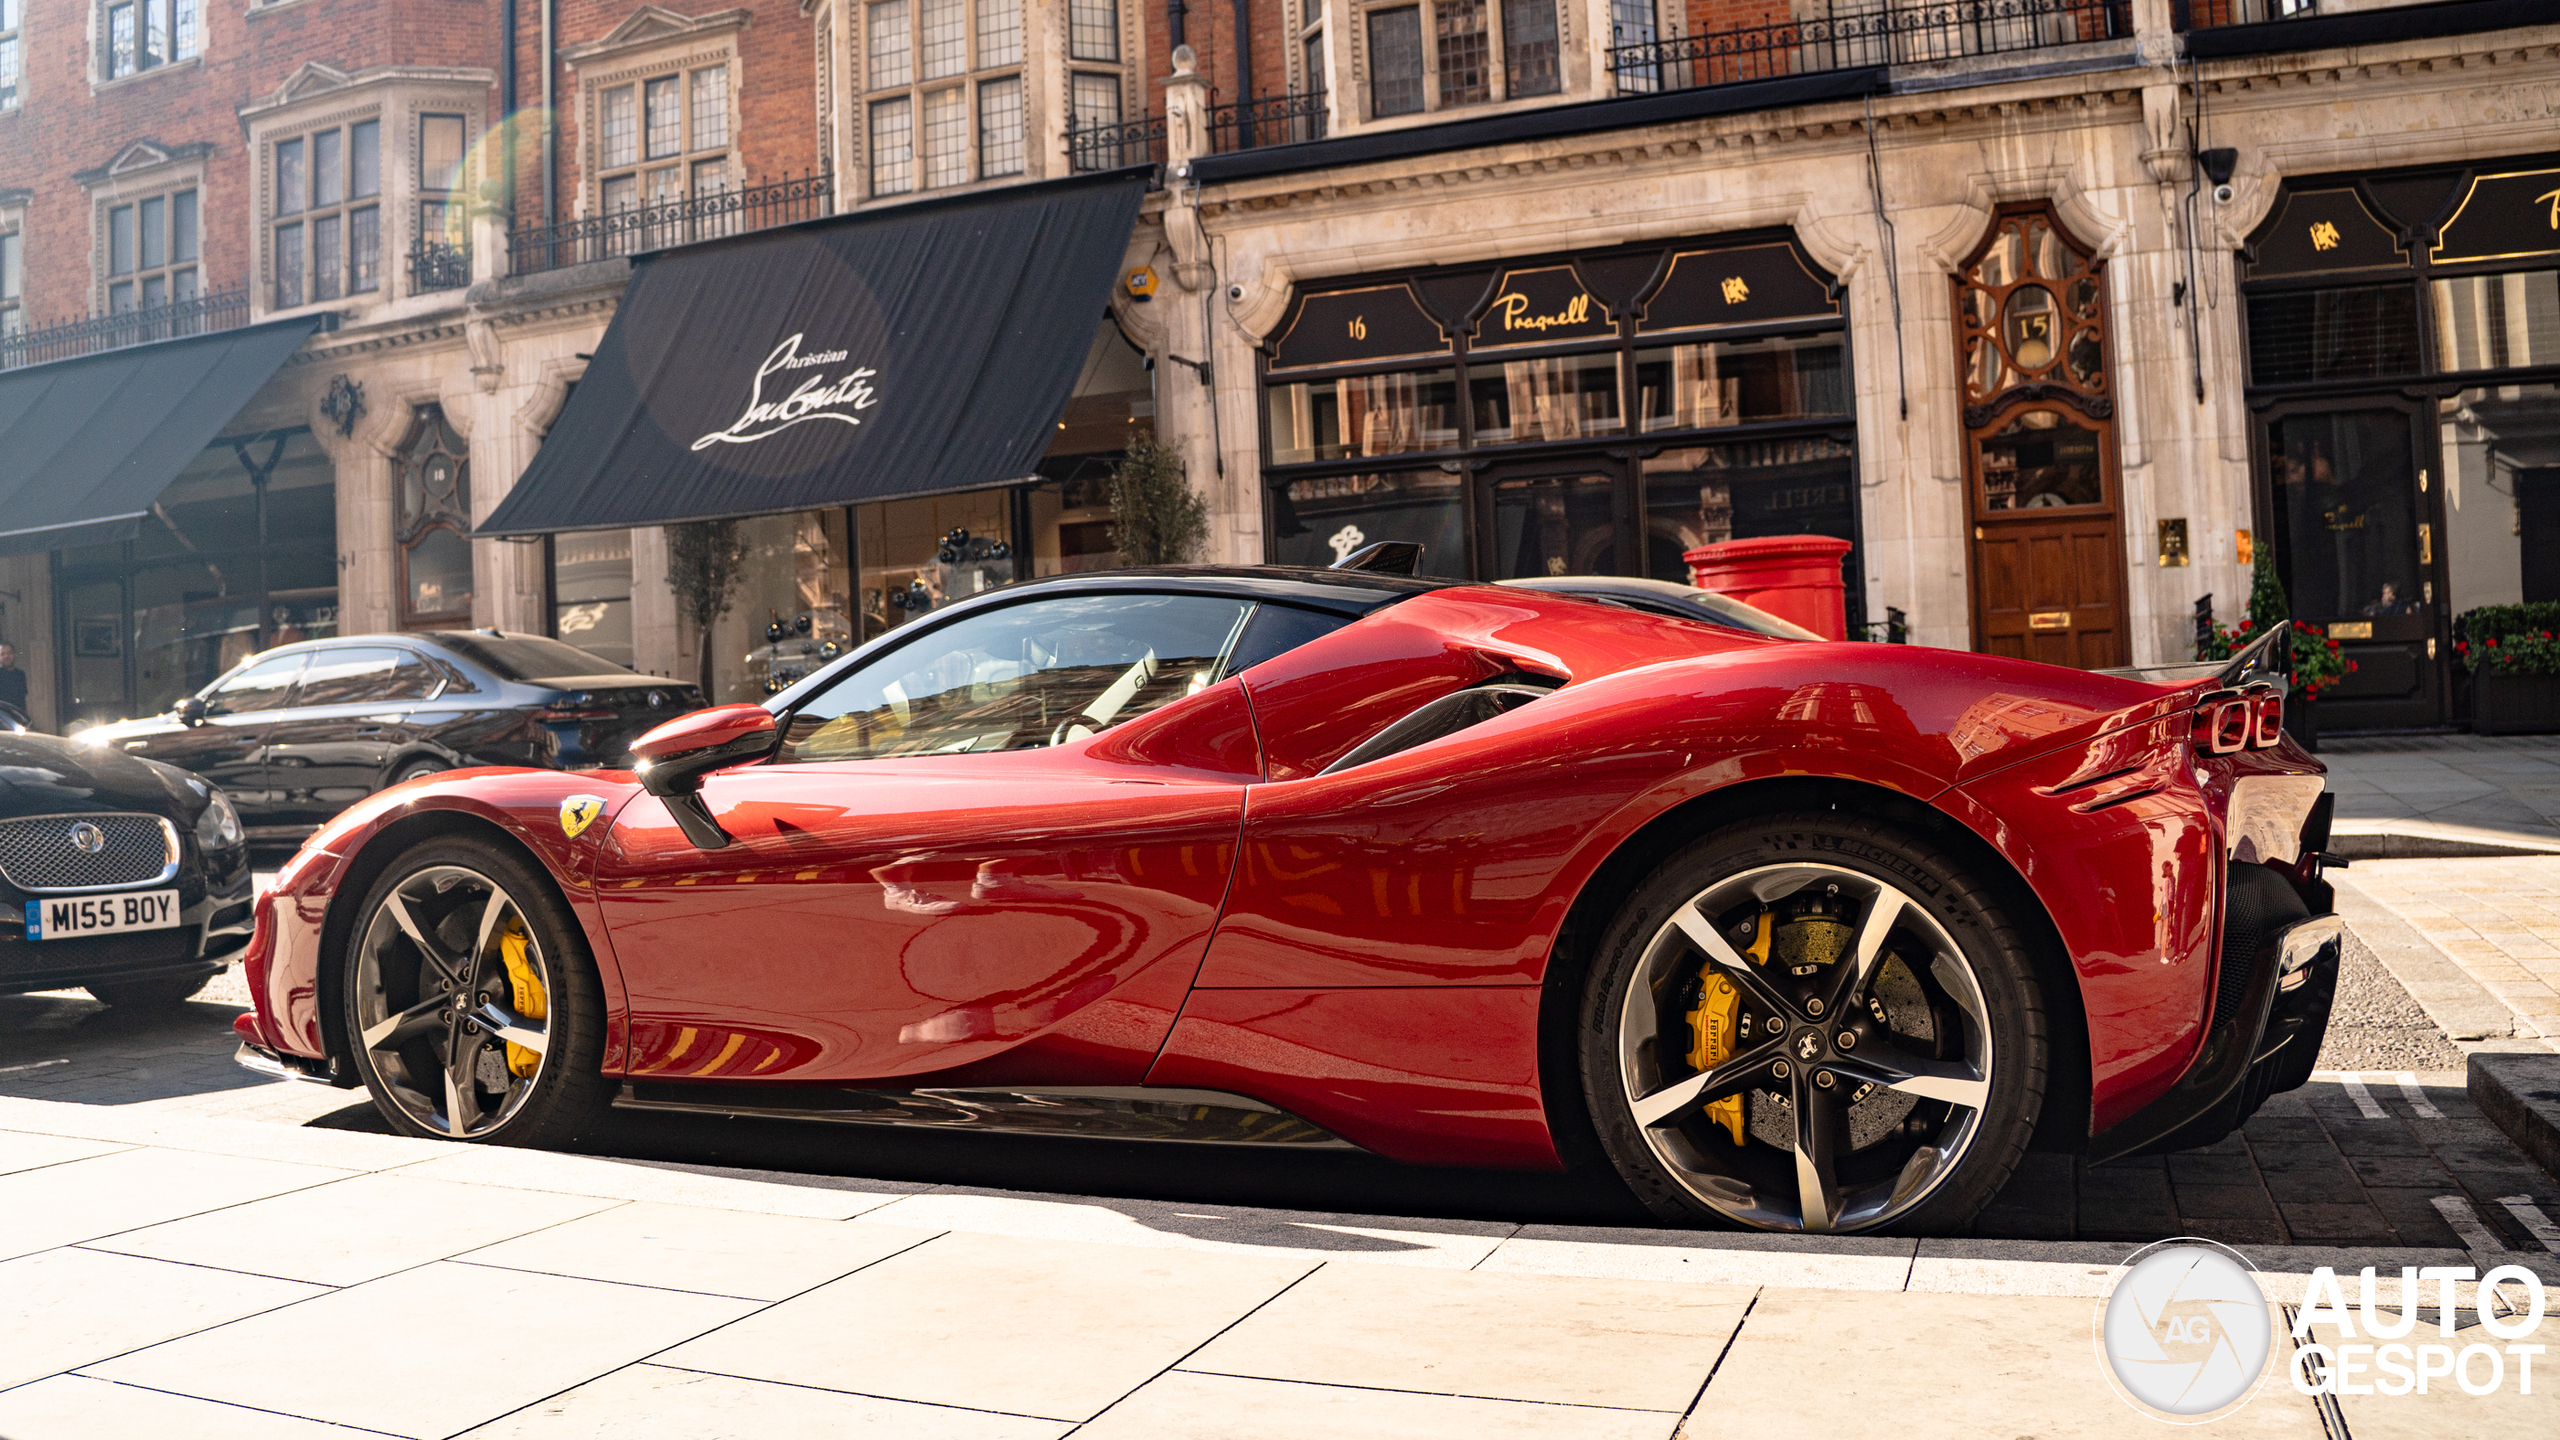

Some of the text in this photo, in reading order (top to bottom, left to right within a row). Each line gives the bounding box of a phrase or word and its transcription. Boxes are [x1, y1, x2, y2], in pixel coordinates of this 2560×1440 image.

[1492, 292, 1589, 331] Pragnell
[1348, 315, 1366, 340] 16
[2021, 315, 2047, 339] 15
[691, 333, 878, 450] Louboutin
[434, 469, 445, 481] 18
[1838, 836, 1943, 898] MICHELIN
[124, 895, 171, 925] BOY
[29, 925, 40, 934] GB
[1710, 1019, 1718, 1061] Ferrari
